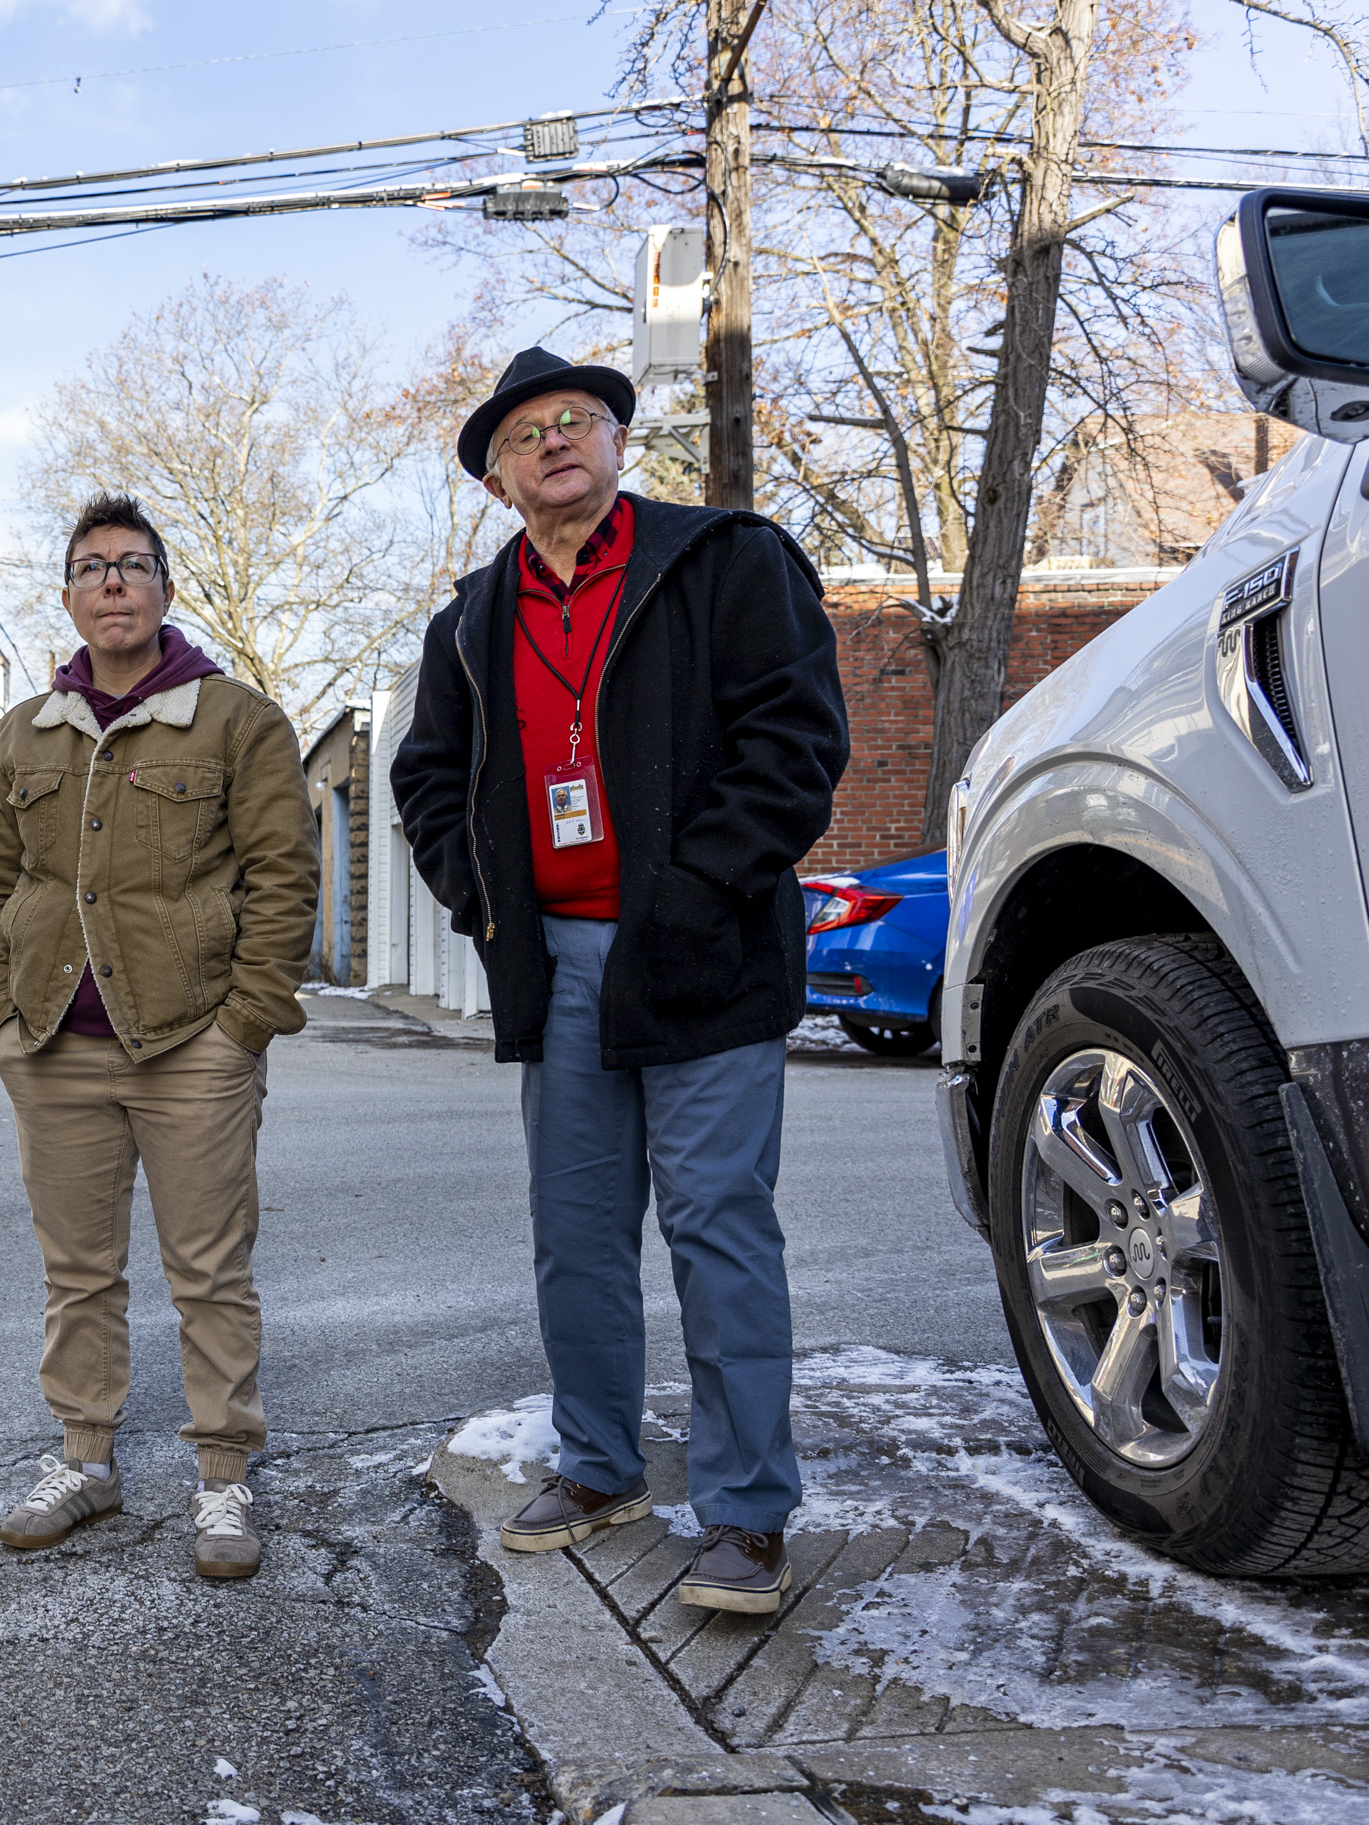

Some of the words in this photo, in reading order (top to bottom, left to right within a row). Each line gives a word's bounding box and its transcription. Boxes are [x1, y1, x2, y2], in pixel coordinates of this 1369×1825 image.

[1221, 605, 1242, 624] KING
[1246, 582, 1276, 610] RANCH
[1224, 562, 1283, 608] F-150
[1023, 1003, 1060, 1052] ATR
[1151, 1039, 1202, 1124] PIRELLI
